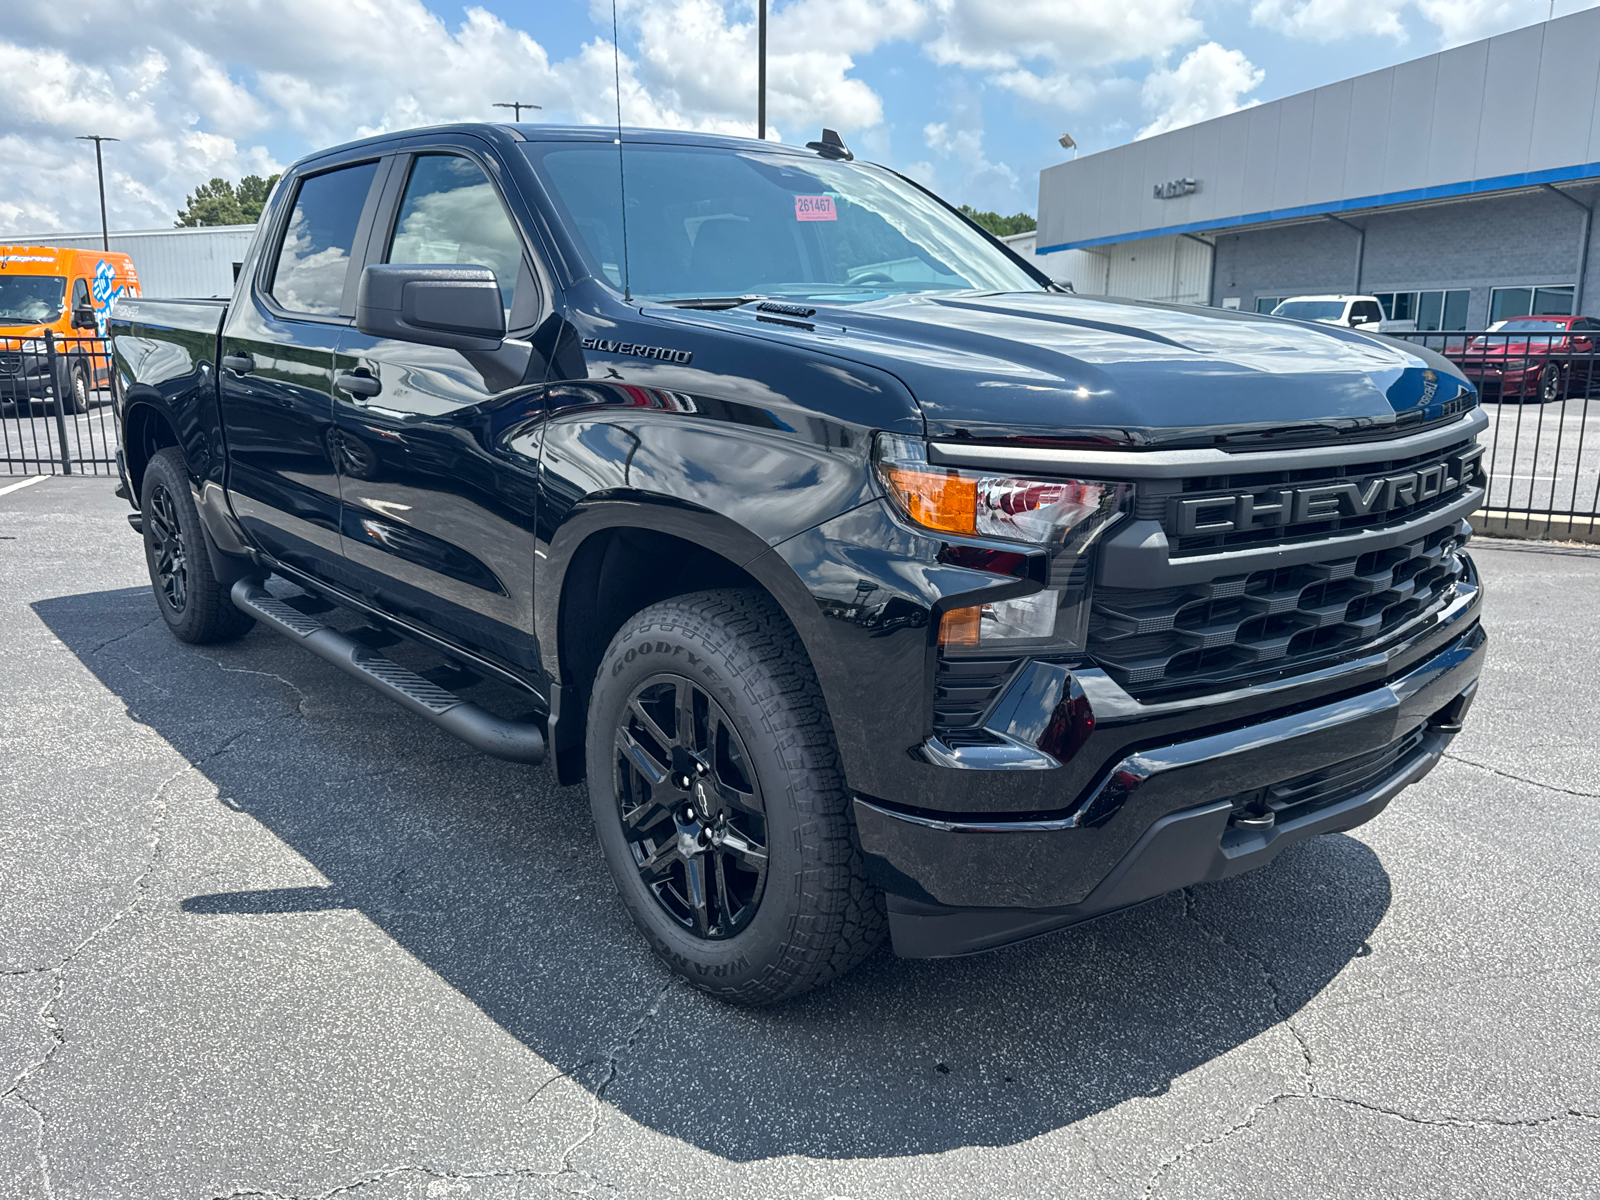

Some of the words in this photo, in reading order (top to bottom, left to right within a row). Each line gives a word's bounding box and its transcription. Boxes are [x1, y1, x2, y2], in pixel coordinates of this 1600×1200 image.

[798, 199, 830, 212] 261467
[581, 338, 692, 364] SILVERADO
[611, 641, 757, 740] GOODYEAR
